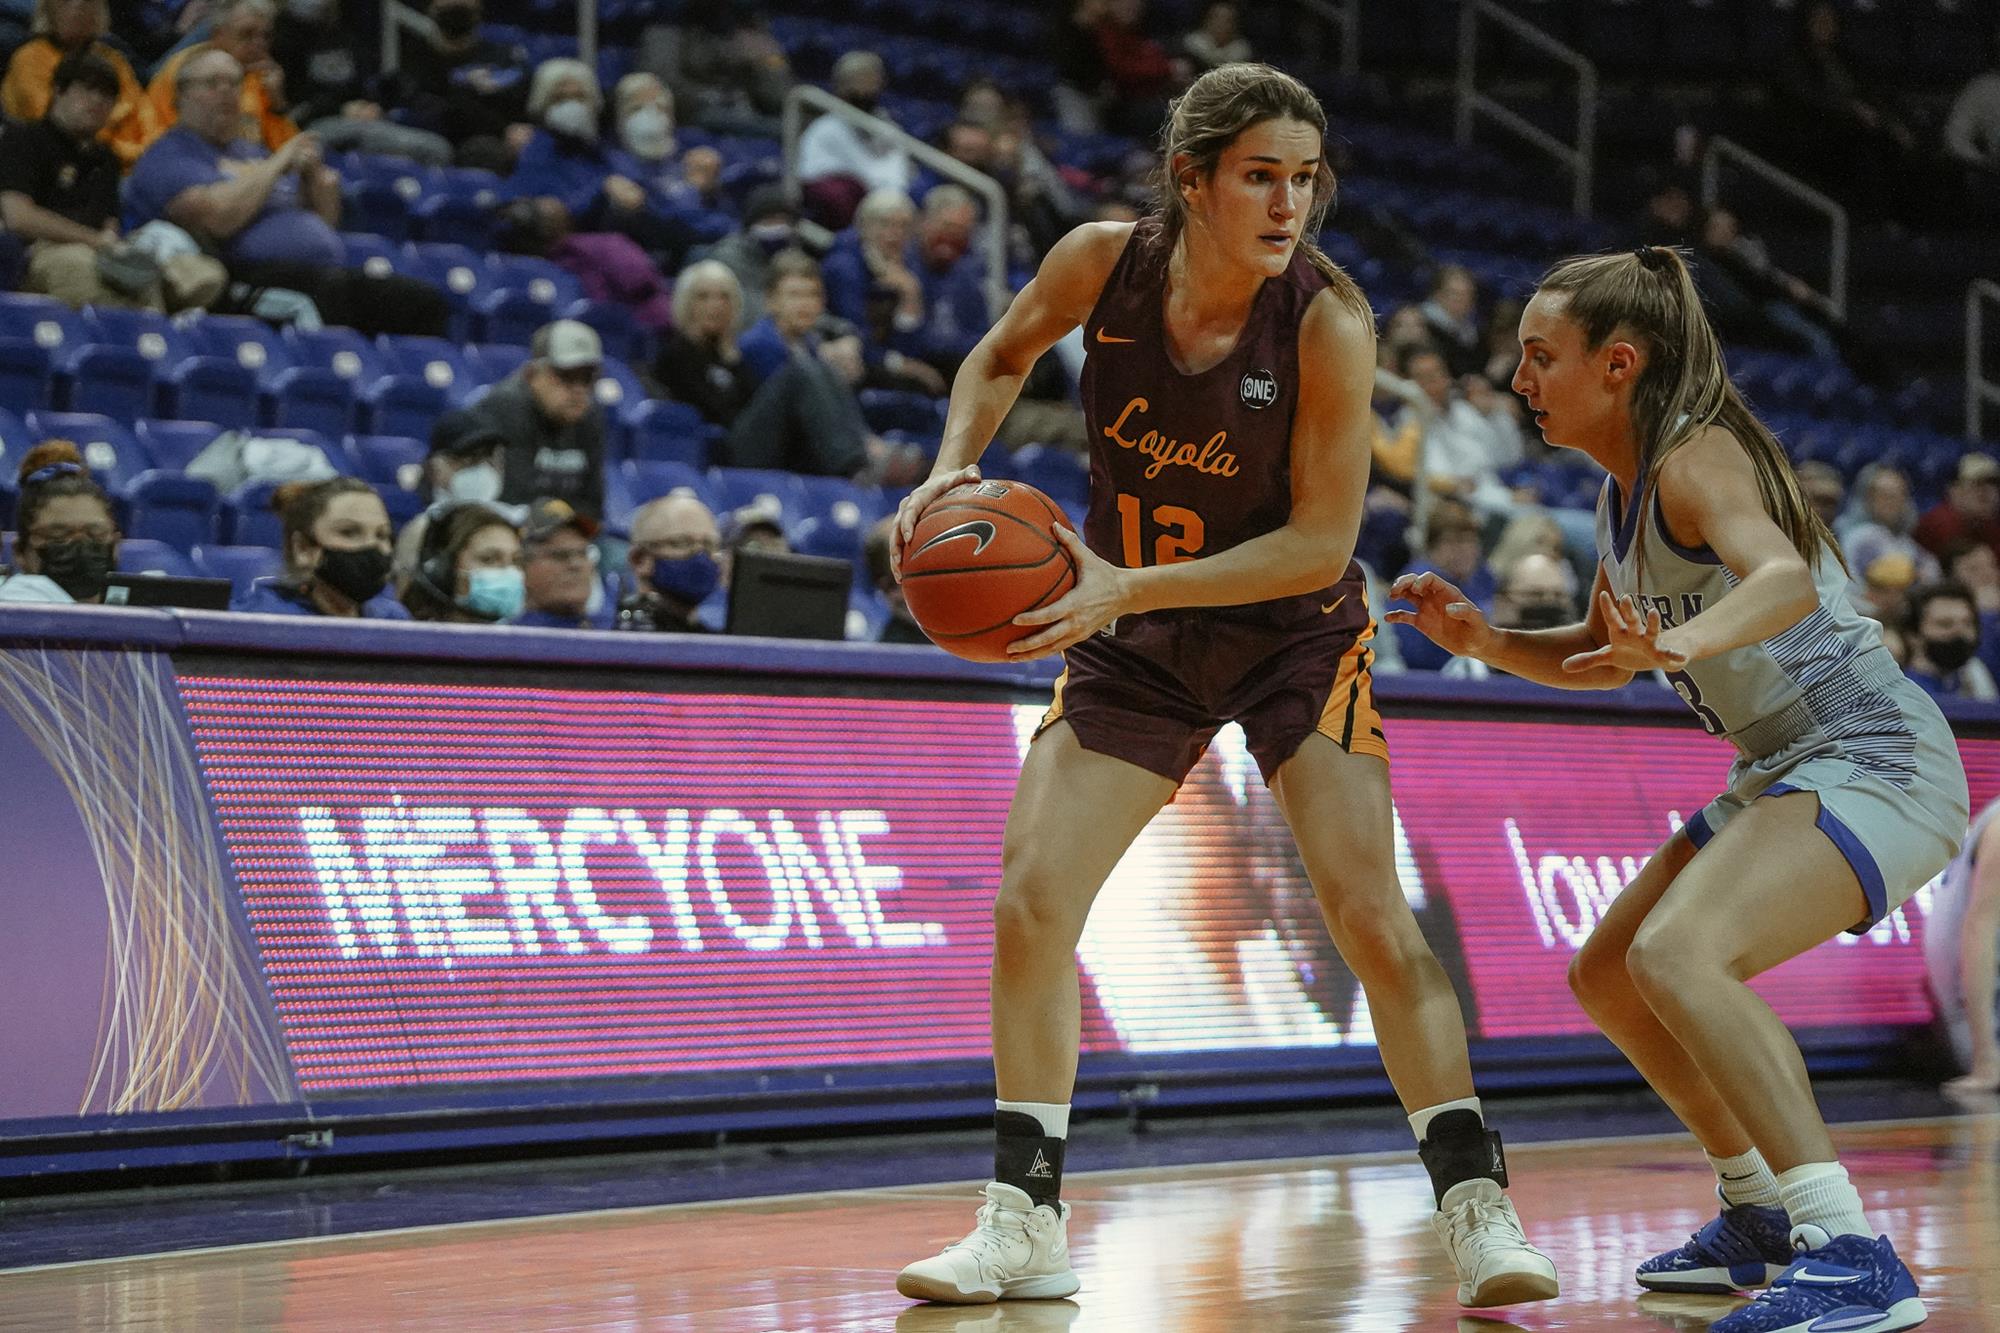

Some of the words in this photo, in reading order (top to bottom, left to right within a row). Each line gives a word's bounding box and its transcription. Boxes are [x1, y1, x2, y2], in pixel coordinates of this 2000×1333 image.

[1243, 377, 1274, 401] ONE
[1104, 397, 1240, 480] Loyola
[1117, 493, 1205, 569] 12
[1629, 592, 1704, 632] ERN
